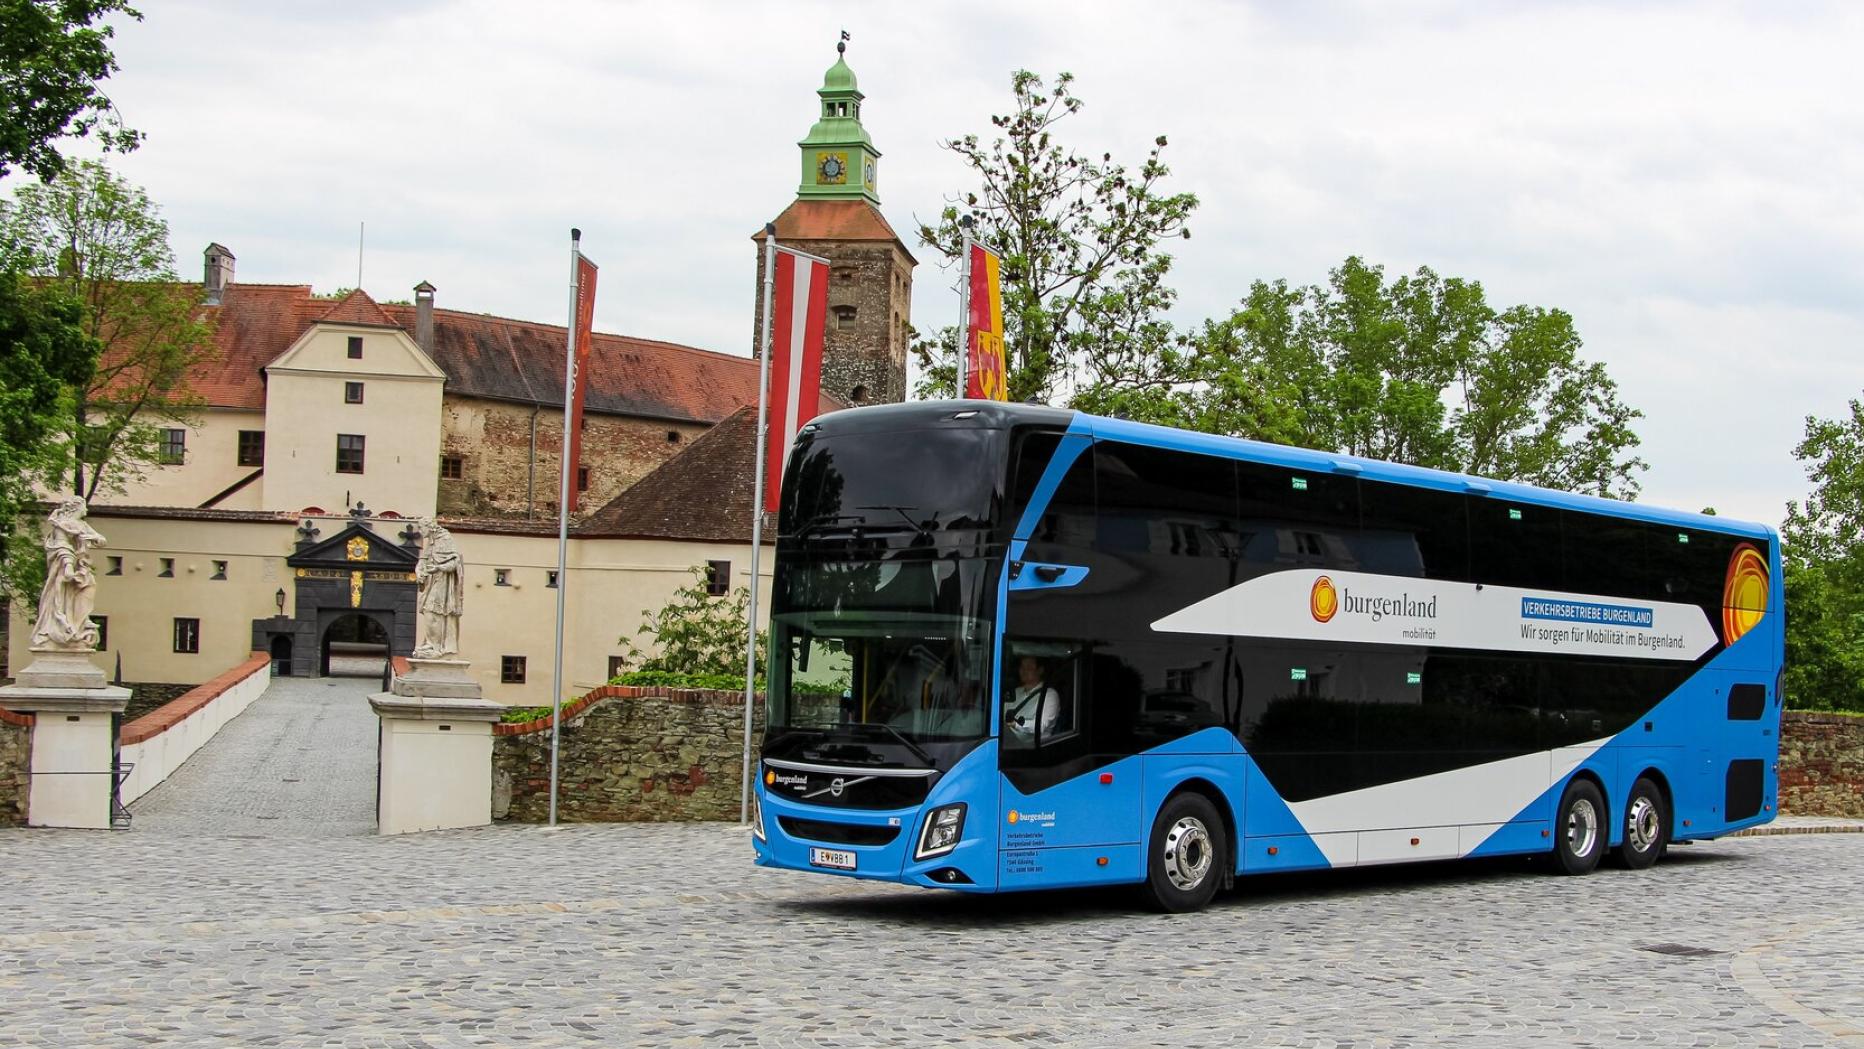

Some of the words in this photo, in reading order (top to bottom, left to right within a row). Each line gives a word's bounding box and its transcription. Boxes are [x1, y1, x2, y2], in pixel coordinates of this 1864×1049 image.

[1344, 587, 1437, 623] burgenland
[1523, 601, 1601, 620] VERKEHRSBETRIEBE
[1602, 608, 1651, 624] BURGENLAND
[1402, 627, 1437, 640] mobilität
[1520, 623, 1537, 640] Wir
[1538, 626, 1569, 645] sorgen
[1571, 627, 1584, 643] für
[1586, 627, 1624, 646] Mobilität
[1625, 632, 1637, 646] im
[1637, 632, 1686, 651] Burgenland.
[775, 773, 808, 785] burgenland
[1019, 811, 1055, 822] burgenland
